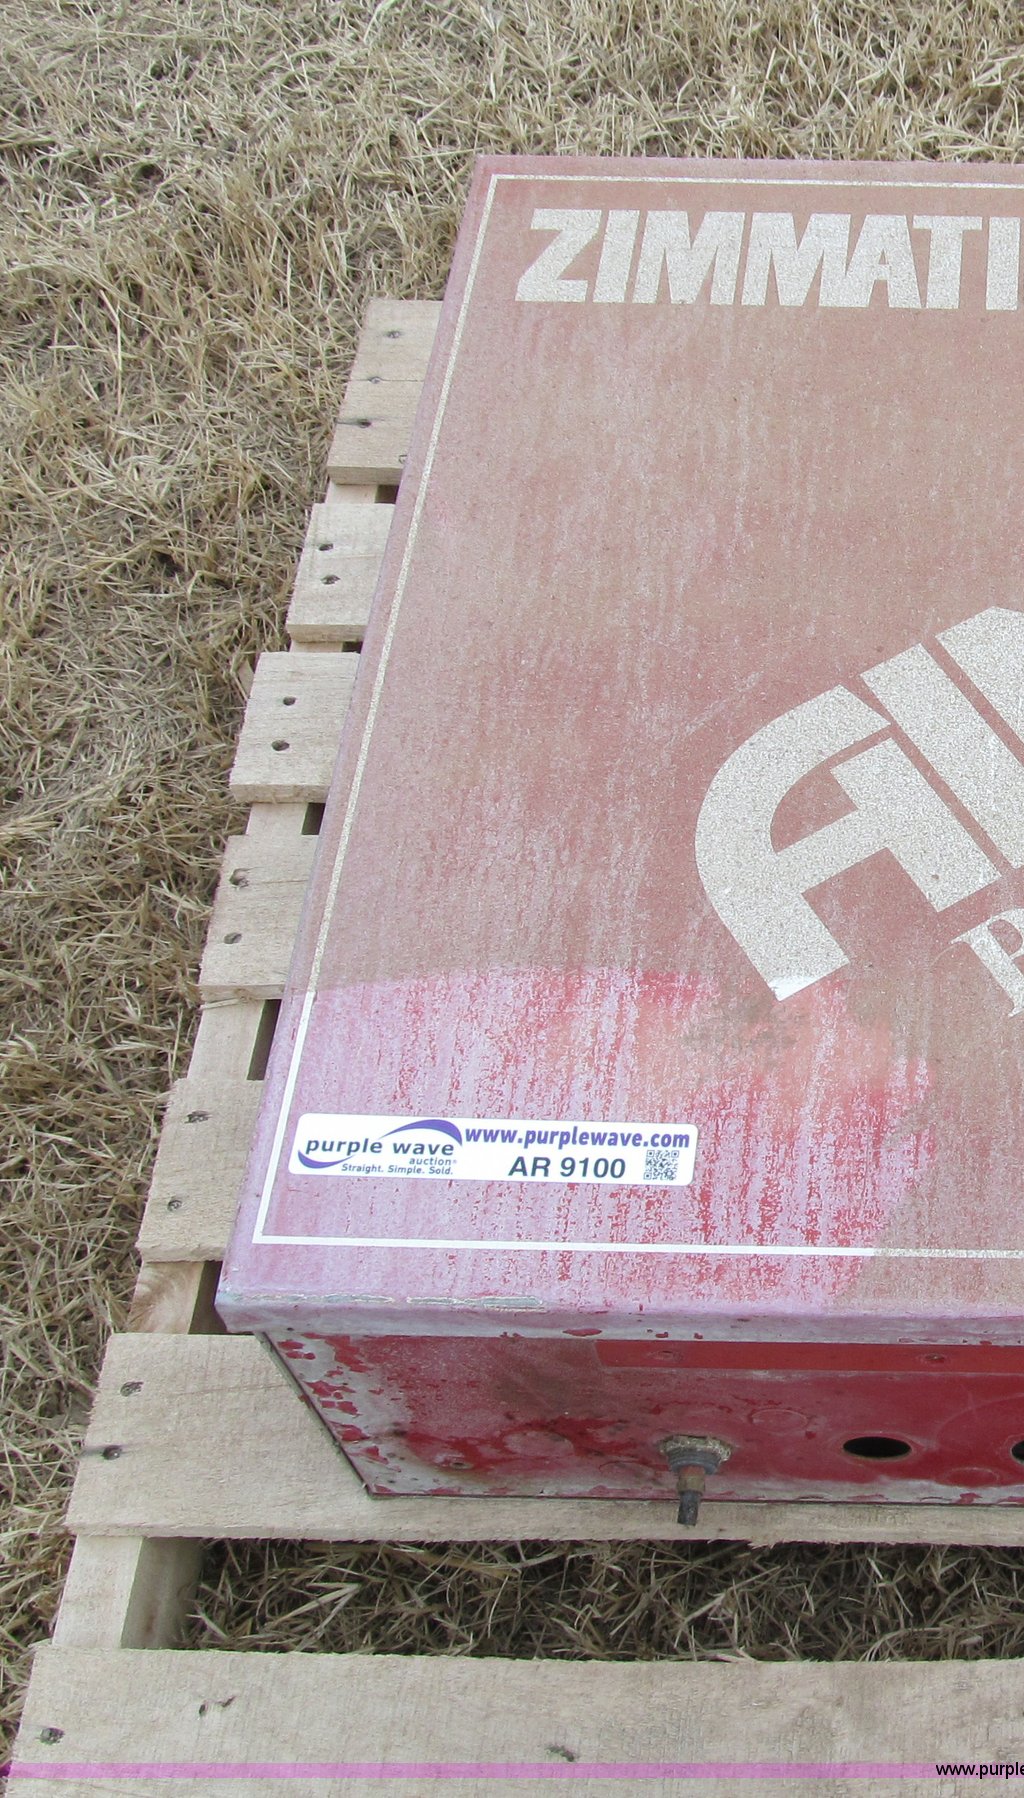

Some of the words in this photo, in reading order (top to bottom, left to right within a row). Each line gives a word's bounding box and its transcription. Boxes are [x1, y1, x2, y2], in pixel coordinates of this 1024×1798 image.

[465, 1126, 691, 1149] www.purplewave.com
[305, 1138, 383, 1156] purple
[393, 1142, 455, 1156] wave
[341, 1163, 384, 1175] Straight.
[387, 1164, 425, 1175] Simple.
[428, 1166, 454, 1175] Sold.
[409, 1156, 451, 1166] auction
[508, 1156, 551, 1178] AR
[560, 1157, 626, 1179] 9100
